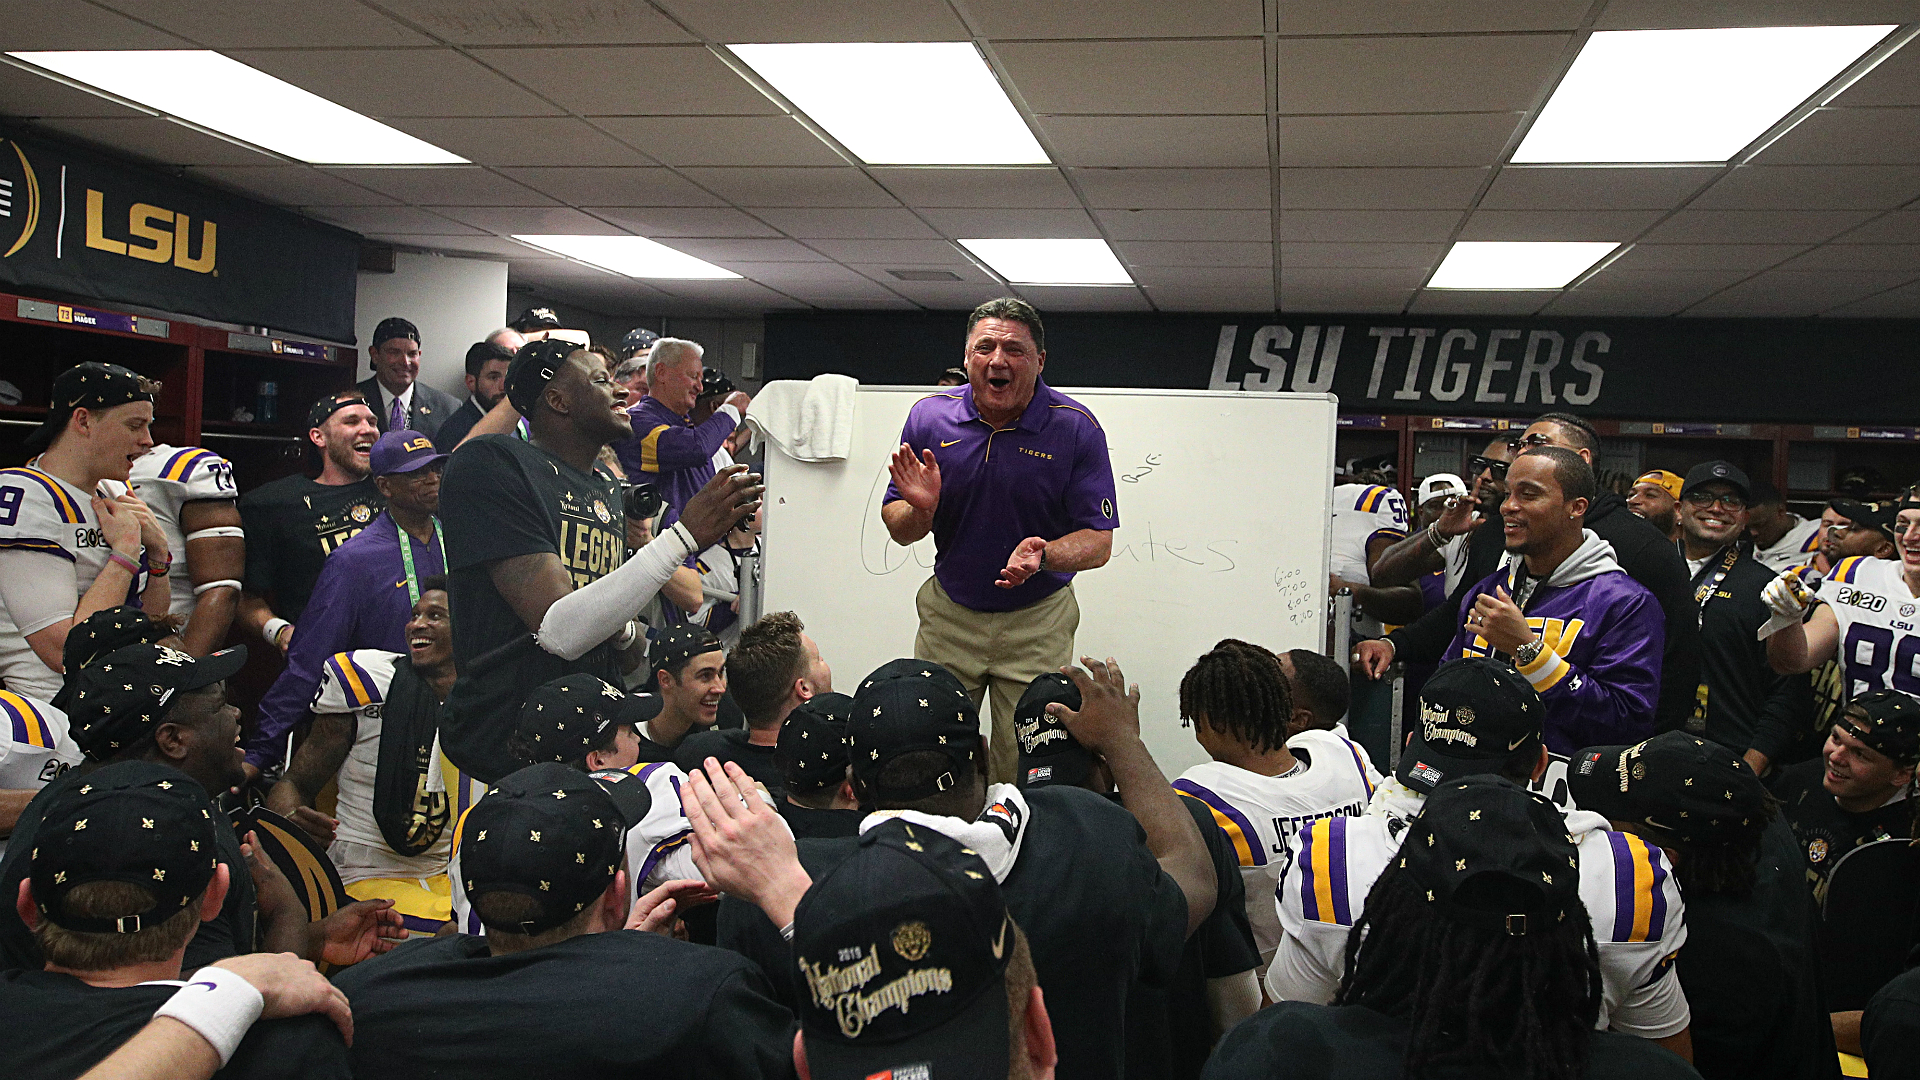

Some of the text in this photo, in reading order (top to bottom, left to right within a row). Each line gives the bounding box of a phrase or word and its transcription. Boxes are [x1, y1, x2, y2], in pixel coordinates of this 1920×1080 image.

[86, 188, 217, 274] LSU
[60, 309, 70, 320] 73
[1208, 325, 1611, 405] LSU TIGERS
[403, 438, 432, 452] LSU
[1019, 447, 1053, 460] TIGERS
[1837, 587, 1887, 612] 2020
[1889, 620, 1914, 631] LSU
[1024, 728, 1068, 753] Champions
[1424, 721, 1478, 747] Champions
[799, 943, 882, 1010] National
[836, 967, 952, 1039] Champions
